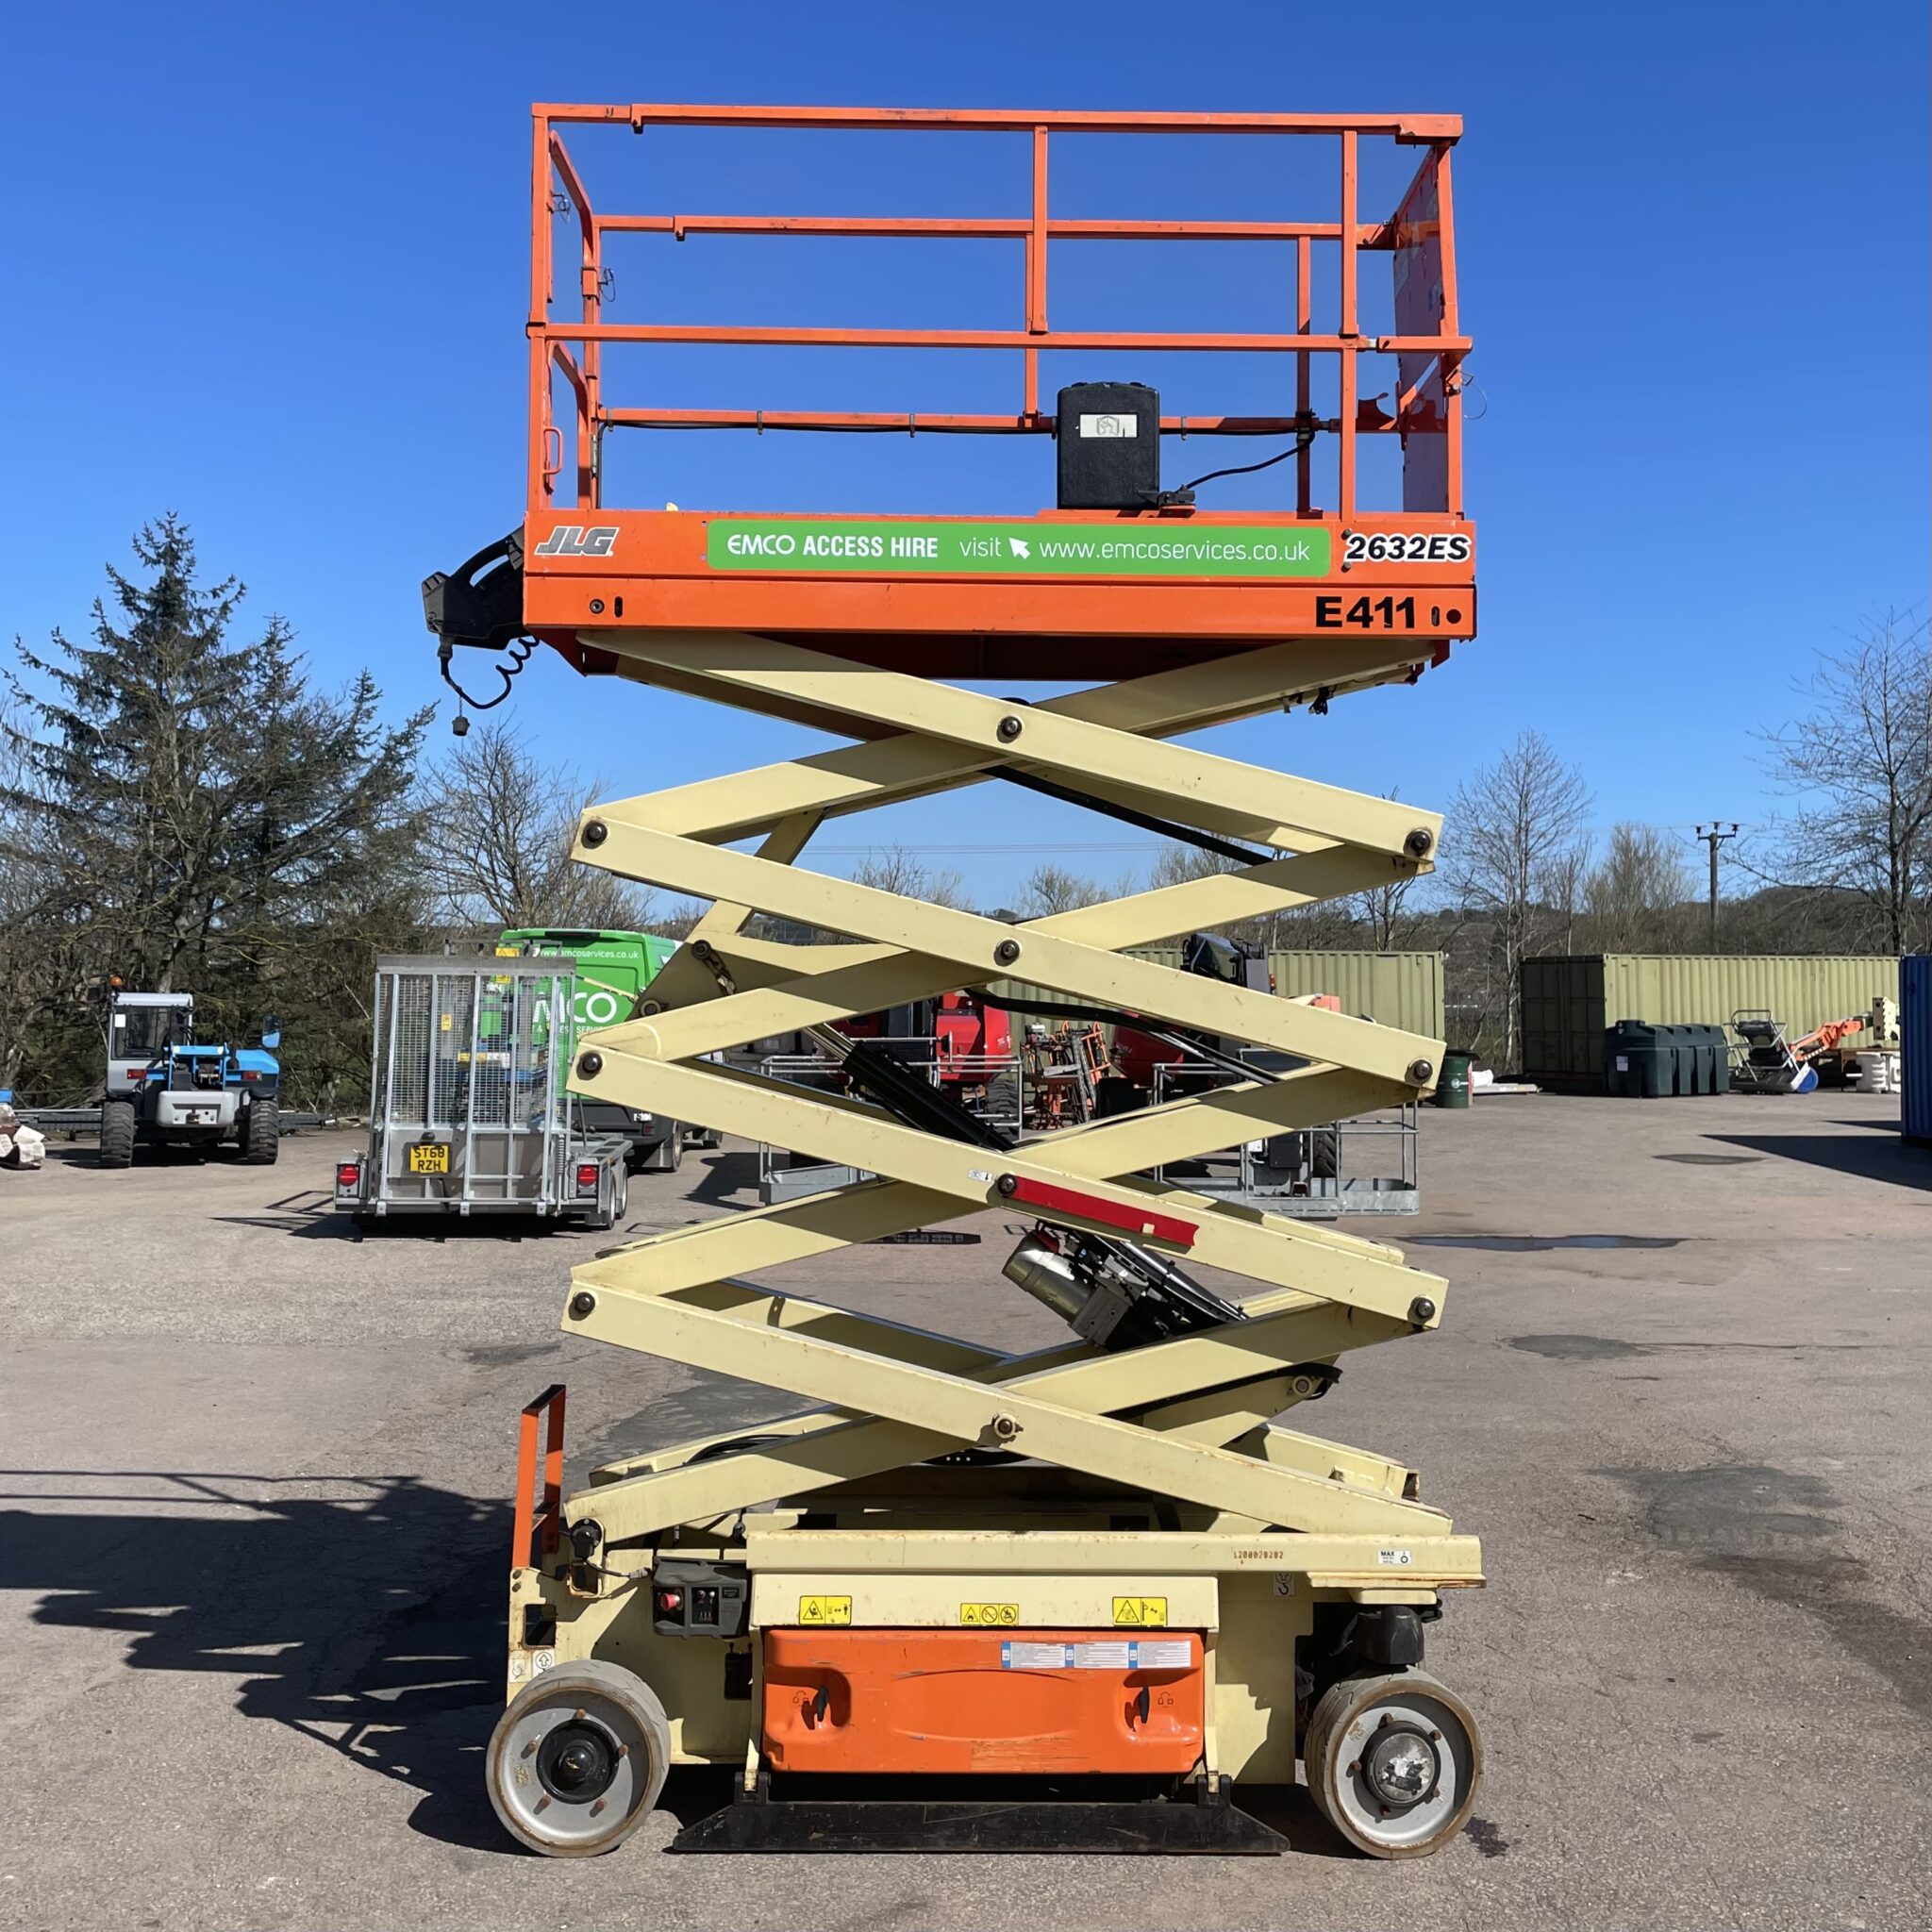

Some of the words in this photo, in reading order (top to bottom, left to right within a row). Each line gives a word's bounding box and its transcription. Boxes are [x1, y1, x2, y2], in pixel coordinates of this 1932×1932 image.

[534, 525, 620, 557] JLG
[726, 534, 796, 555] EMCO
[803, 535, 883, 557] ACCESS
[891, 536, 939, 558] HIRE
[959, 537, 1002, 557] visit
[1039, 539, 1310, 562] www.emcoservices.co.uk
[1344, 533, 1473, 563] 2632ES
[1315, 595, 1416, 629] E411
[532, 991, 617, 1024] MCO
[414, 1146, 445, 1158] ST68
[417, 1159, 441, 1171] RZH
